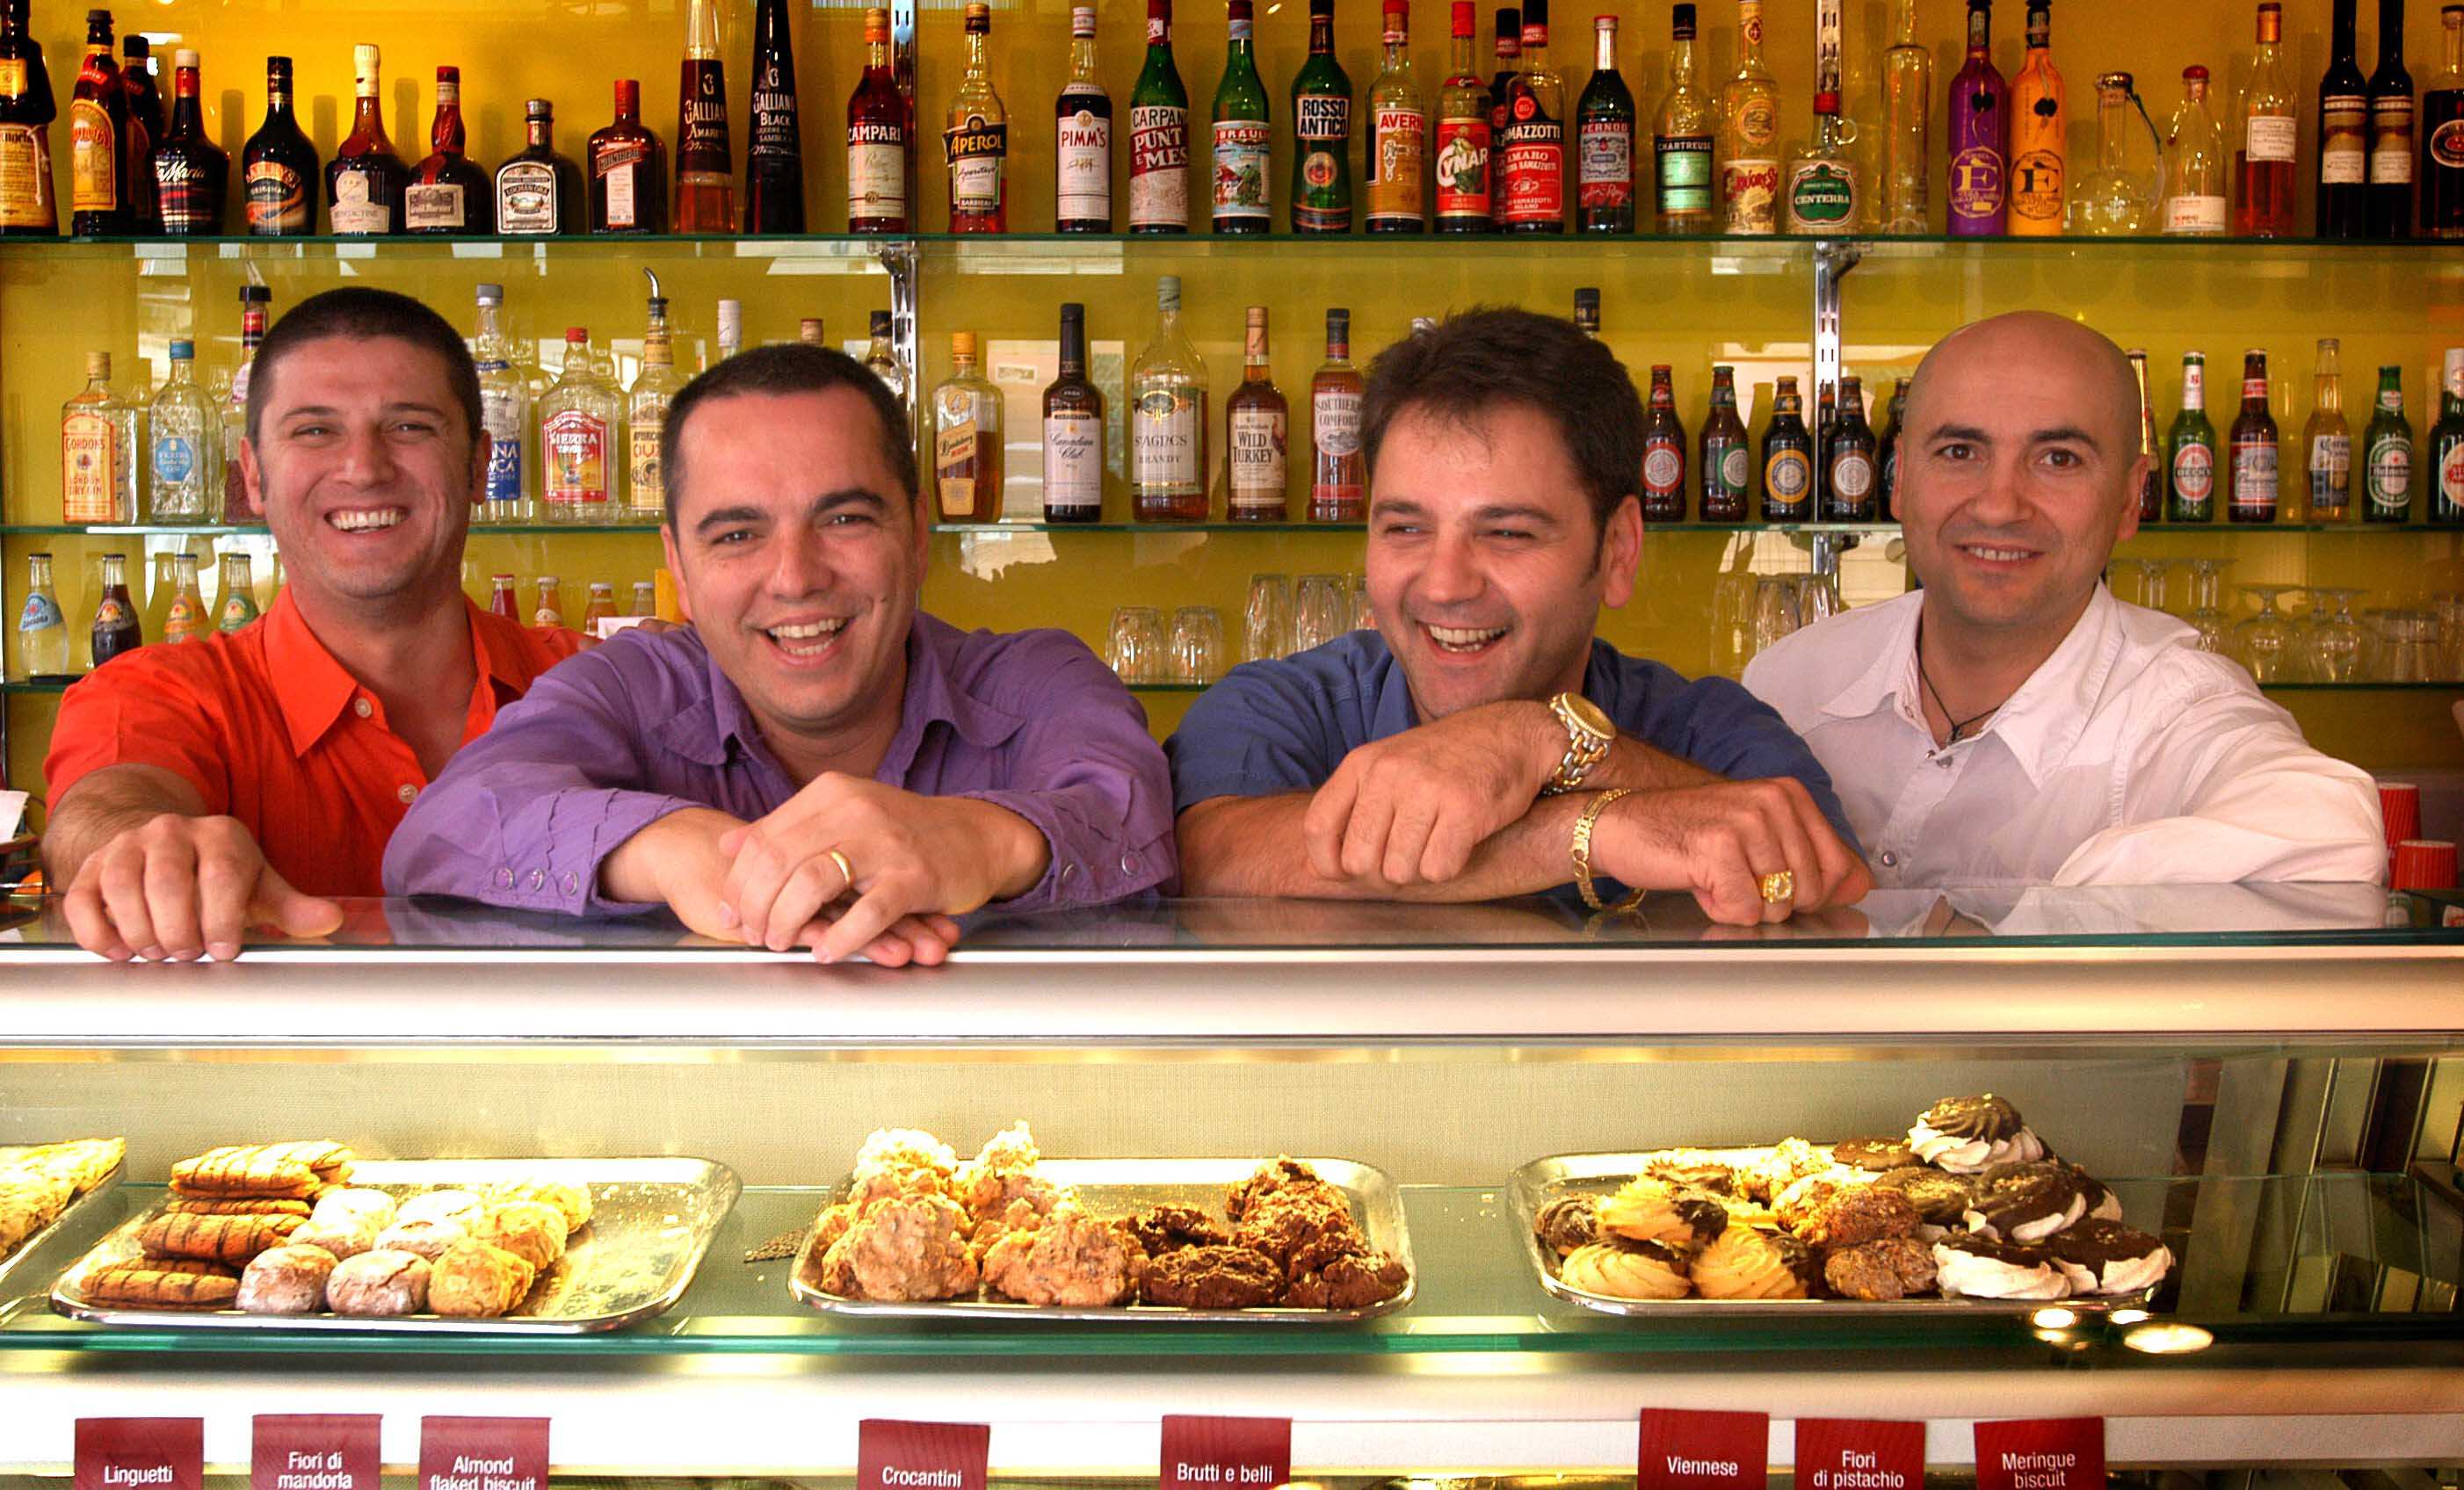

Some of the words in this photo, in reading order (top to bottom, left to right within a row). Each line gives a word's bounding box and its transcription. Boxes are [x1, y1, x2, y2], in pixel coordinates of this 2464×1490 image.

[1133, 108, 1188, 127] CARPAN
[1302, 99, 1345, 117] ROSSO
[760, 112, 791, 127] BLACK
[1300, 118, 1346, 136] ANTICO
[1582, 122, 1628, 134] PERNOD
[848, 125, 901, 142] CAMPARI
[1061, 127, 1106, 148] PIMM'S
[1134, 127, 1182, 153] PUNT
[951, 134, 1004, 155] APEROL
[1136, 153, 1143, 166] E
[1143, 146, 1187, 170] MES
[1436, 144, 1488, 188] CYNAR
[1237, 431, 1267, 448] WILD
[1138, 454, 1181, 464] BRANDY
[1233, 447, 1273, 464] TURKEY
[287, 1450, 323, 1471] Fiori
[326, 1450, 344, 1471] di
[452, 1455, 515, 1475] Almond
[1666, 1455, 1739, 1477] Viennese
[1842, 1450, 1876, 1468] Fiori
[2001, 1451, 2076, 1472] Meringue
[103, 1465, 173, 1487] Linguetti
[277, 1471, 353, 1490] mandorla
[430, 1474, 479, 1490] flaked
[483, 1476, 537, 1490] biscuit
[881, 1465, 963, 1489] Crocantini
[1177, 1462, 1220, 1481] Brutti
[1225, 1466, 1236, 1483] e
[1240, 1464, 1273, 1484] belli
[1813, 1469, 1829, 1487] di
[1833, 1470, 1905, 1490] pistachio
[2014, 1470, 2067, 1490] biscuit
